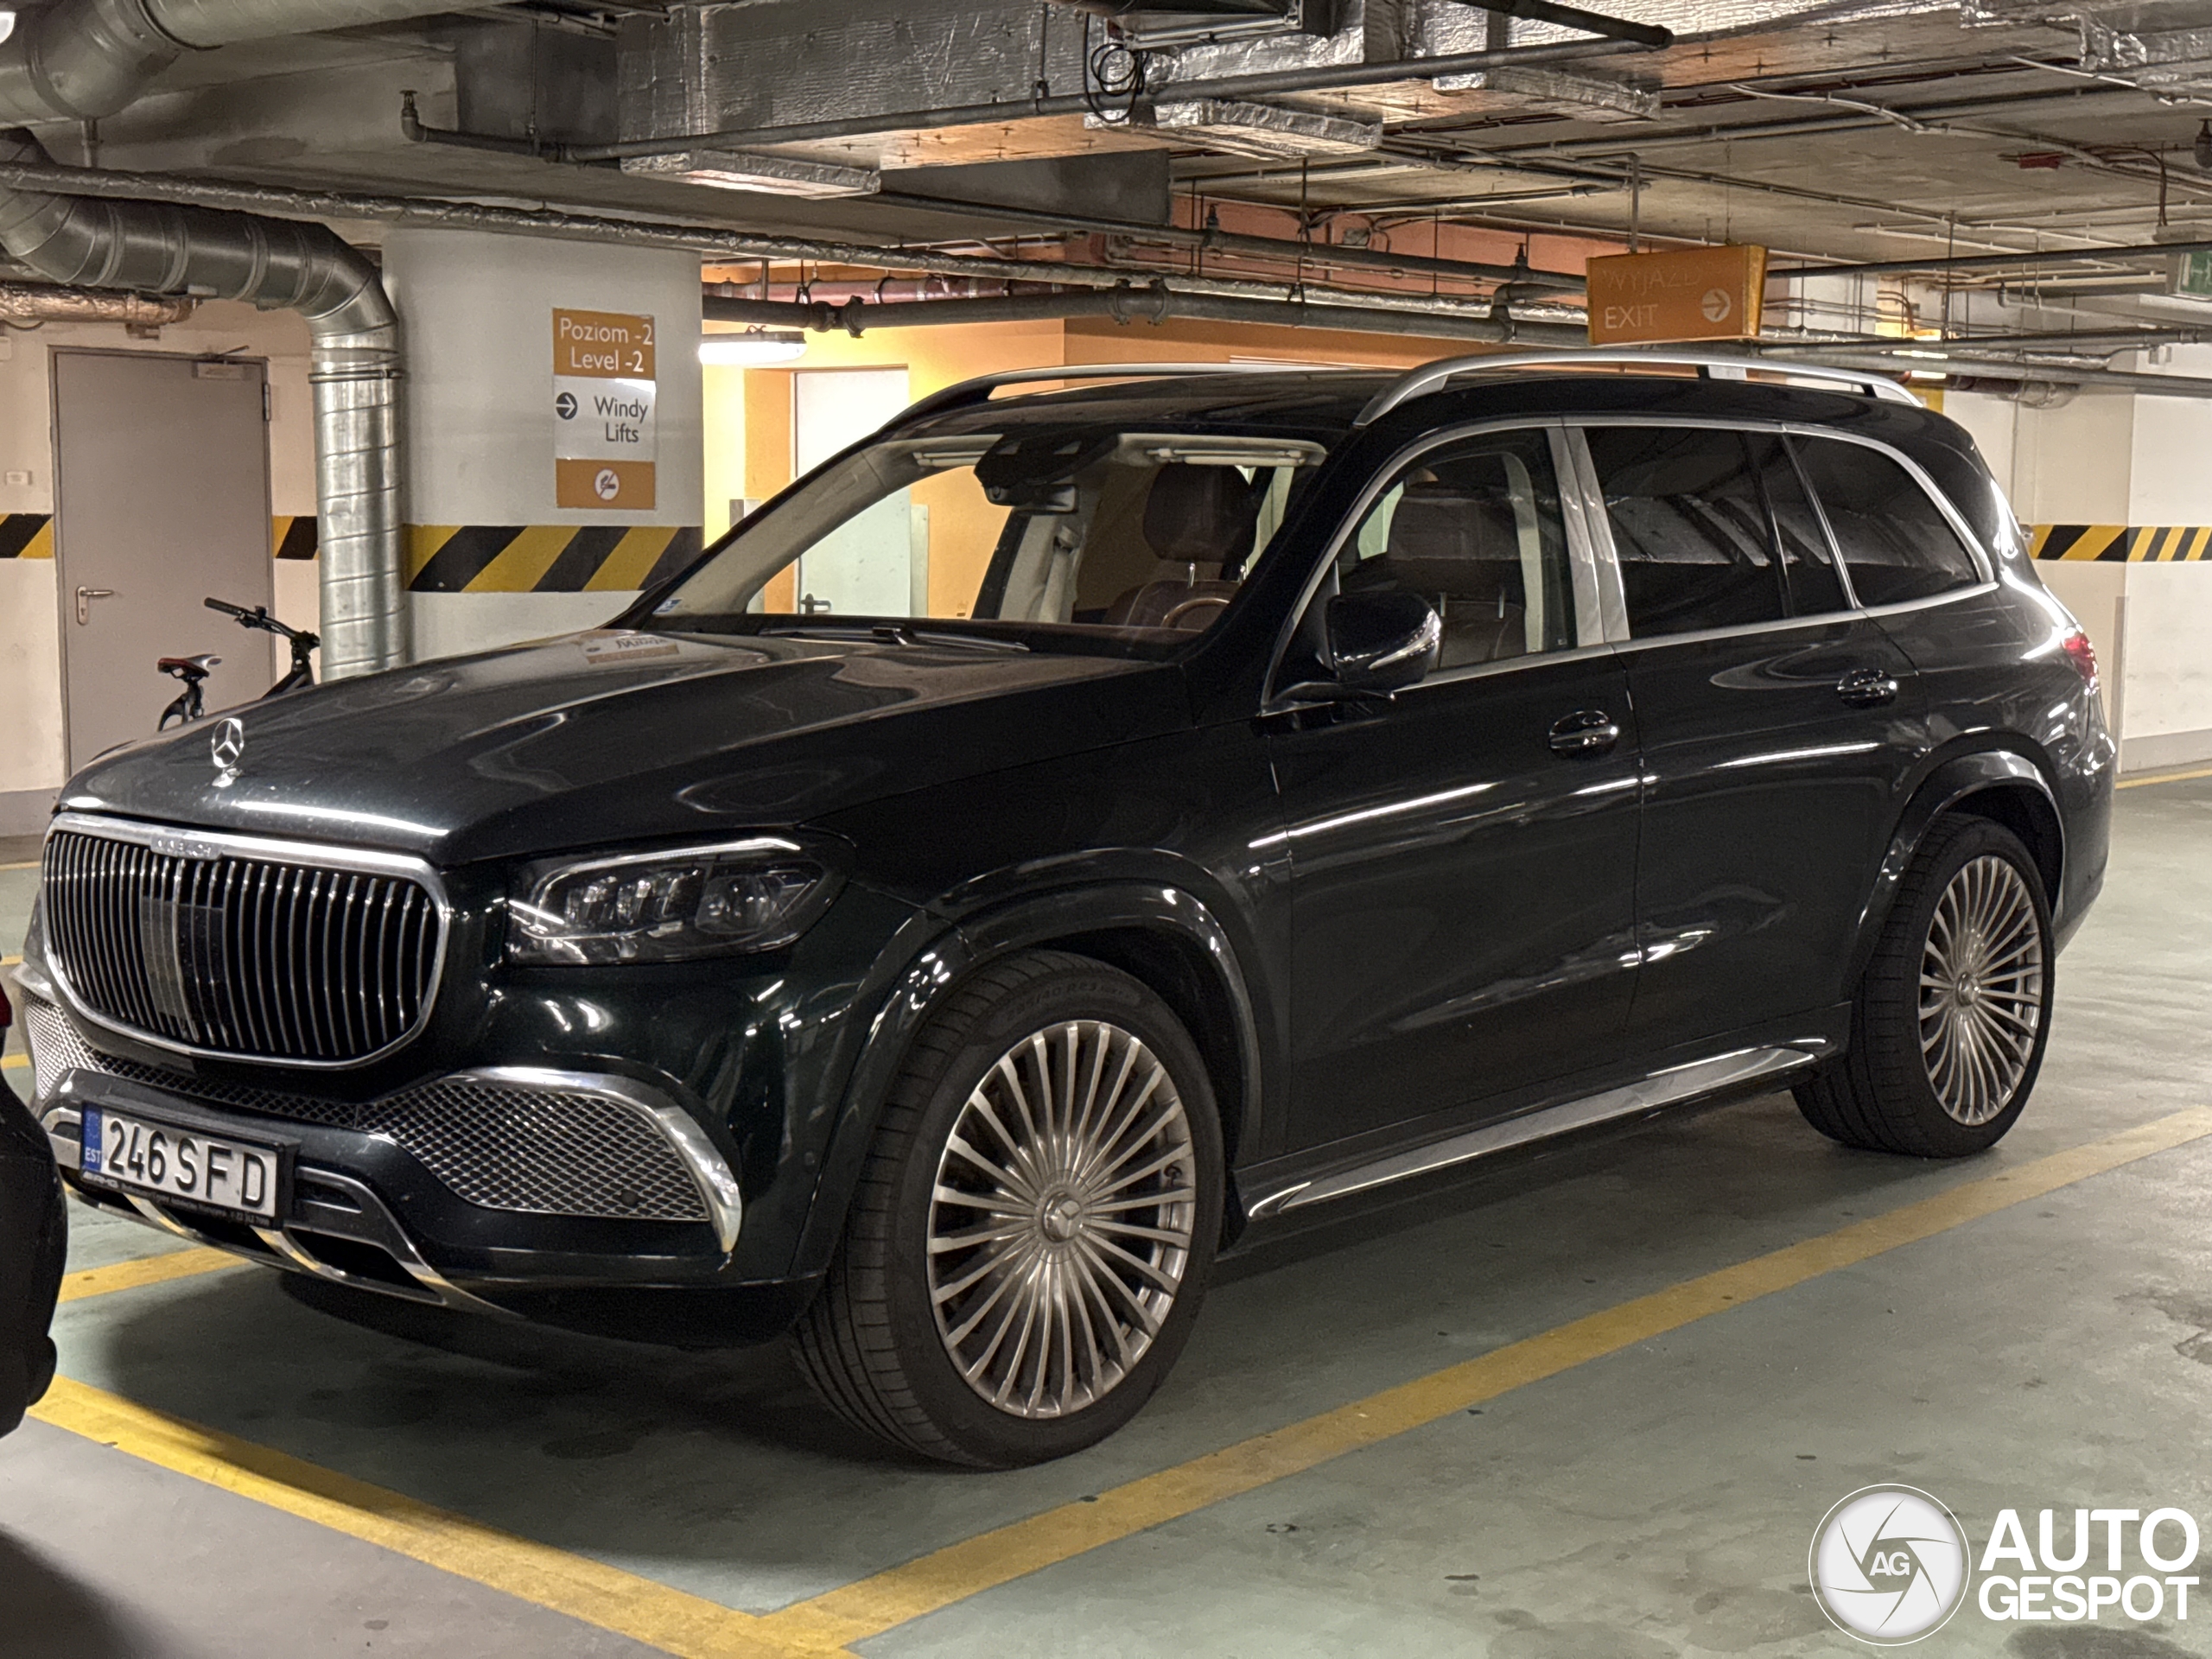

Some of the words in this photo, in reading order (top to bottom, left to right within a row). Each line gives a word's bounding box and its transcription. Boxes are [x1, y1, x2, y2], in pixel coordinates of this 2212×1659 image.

[1605, 303, 1659, 329] EXIT
[560, 317, 629, 344] Poziom
[634, 323, 653, 346] -2
[571, 346, 620, 372] Level
[625, 351, 645, 372] -2
[594, 395, 648, 424] Windy
[605, 423, 639, 443] Lifts
[85, 1147, 102, 1164] EST
[109, 1118, 168, 1185] 246
[175, 1137, 267, 1209] SFD
